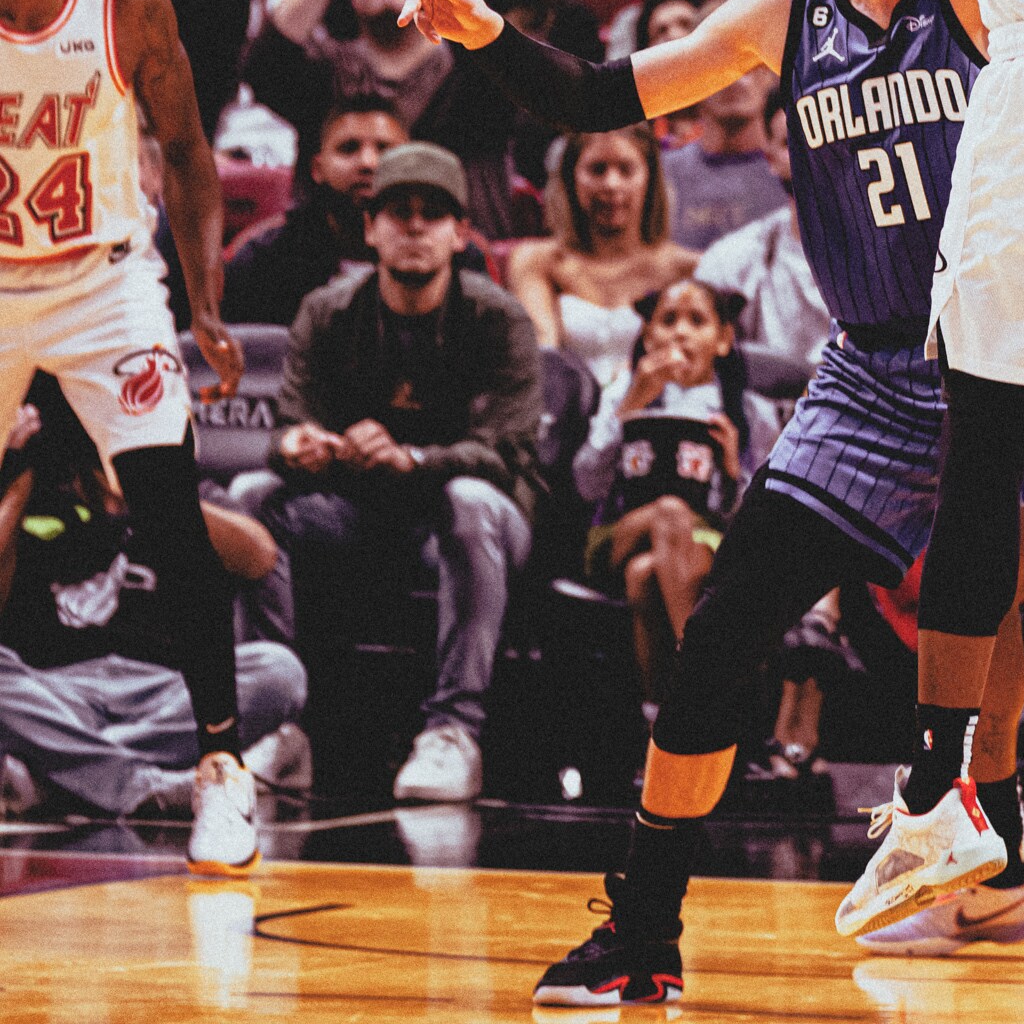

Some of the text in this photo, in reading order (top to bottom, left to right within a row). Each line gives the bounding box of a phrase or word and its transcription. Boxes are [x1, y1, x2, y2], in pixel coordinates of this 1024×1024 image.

[812, 6, 829, 26] 6
[796, 69, 968, 150] ORLANDO
[857, 141, 932, 228] 21
